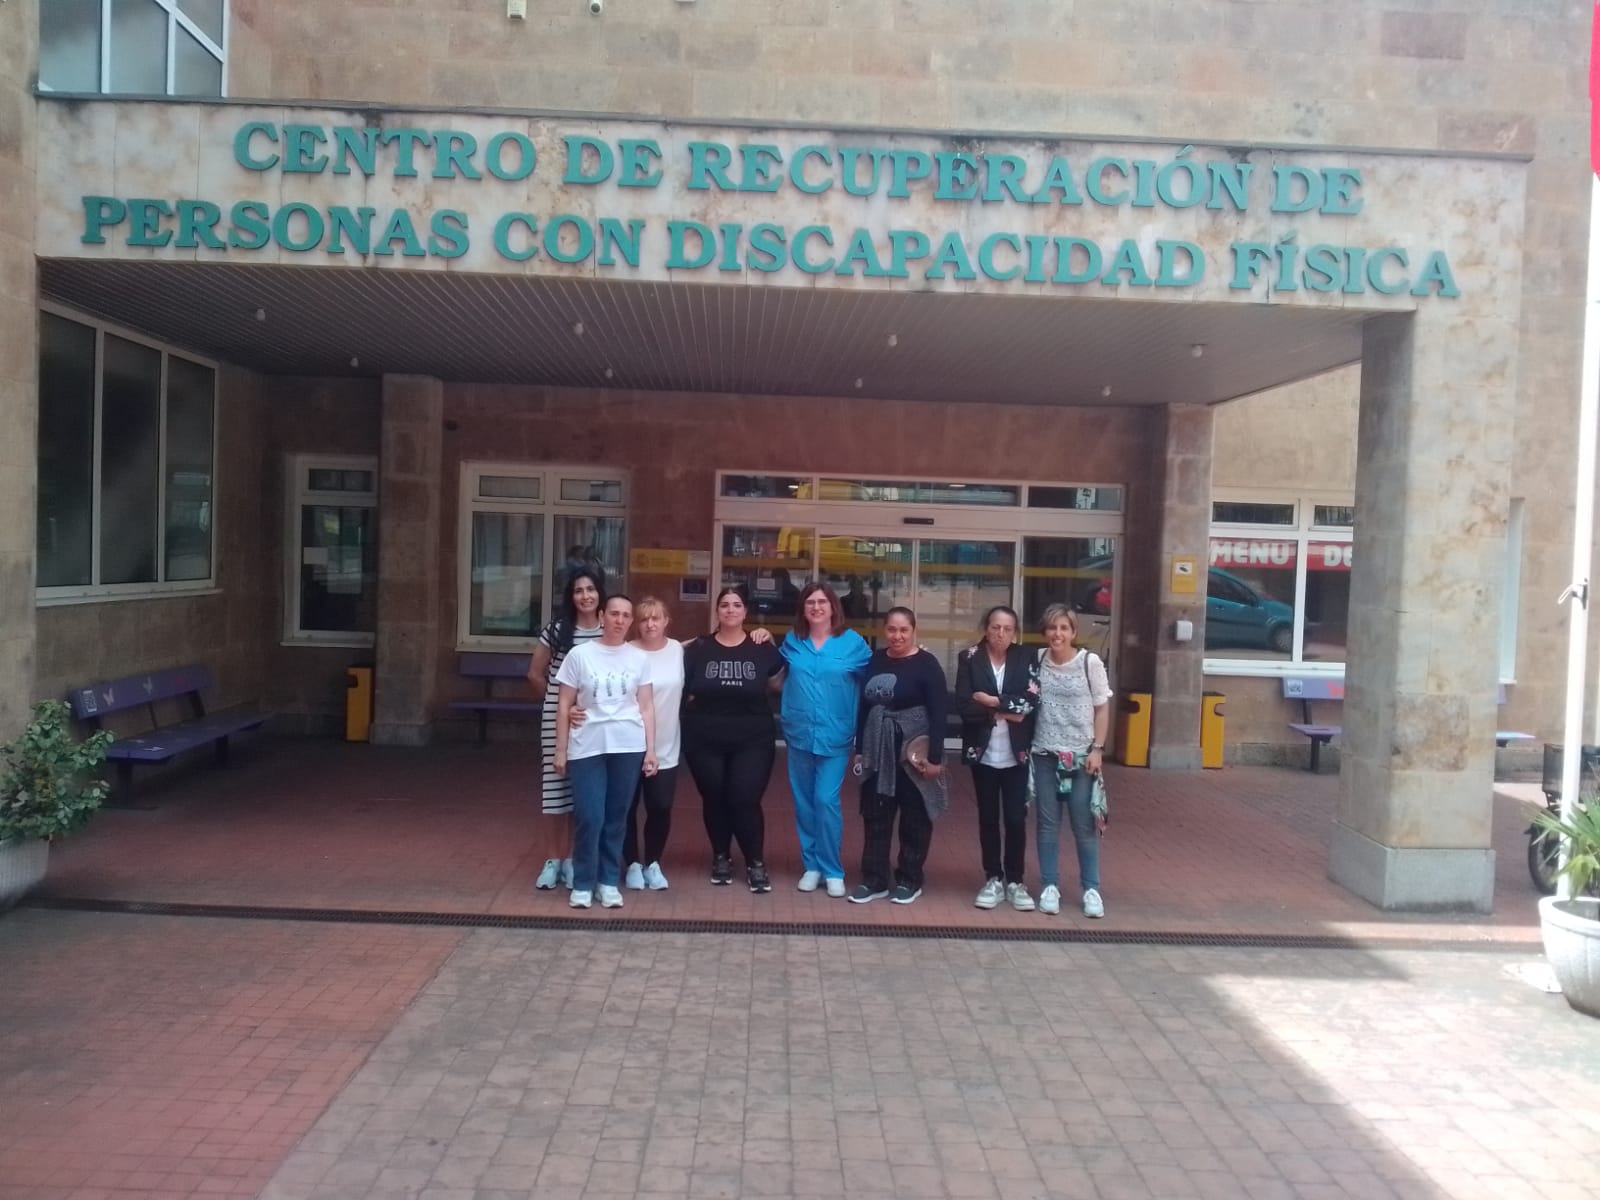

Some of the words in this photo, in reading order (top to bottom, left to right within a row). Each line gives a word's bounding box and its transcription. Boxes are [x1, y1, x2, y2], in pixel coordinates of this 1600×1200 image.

[234, 121, 537, 181] CENTRO
[563, 135, 664, 189] DE
[687, 141, 1253, 212] RECUPERACIÓN
[1272, 165, 1365, 216] DE
[81, 195, 470, 259] PERSONAS
[493, 212, 646, 268] CON
[666, 220, 1205, 288] DISCAPACIDAD
[1230, 232, 1461, 299] FÍSICA
[705, 660, 757, 681] CHIC
